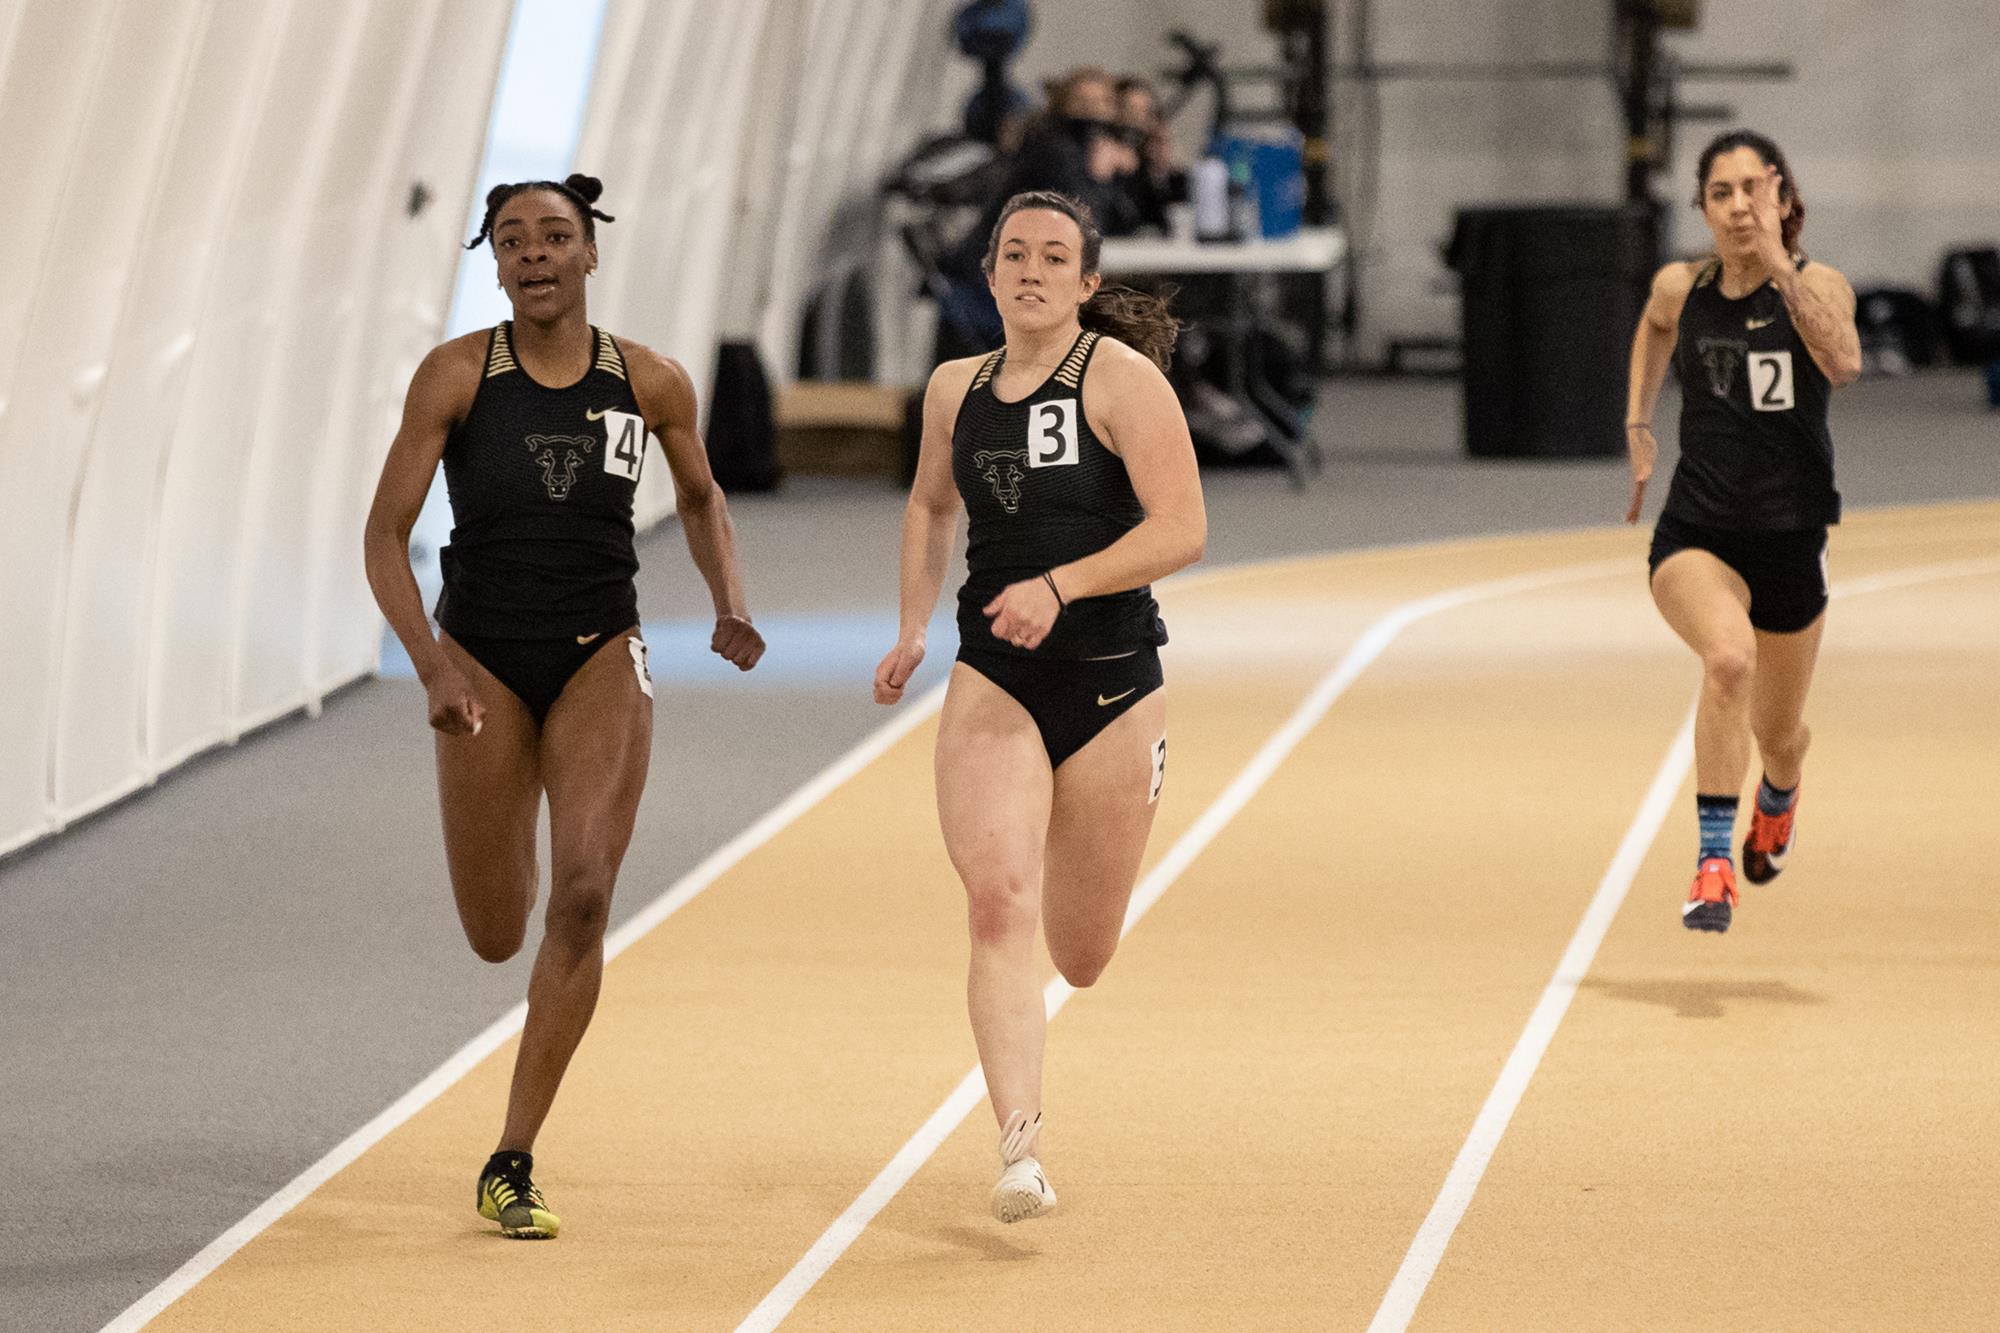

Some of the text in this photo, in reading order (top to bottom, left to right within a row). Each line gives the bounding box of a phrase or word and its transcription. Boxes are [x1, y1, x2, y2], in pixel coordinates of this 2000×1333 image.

[1759, 359, 1785, 405] 2
[614, 418, 638, 475] 4
[1039, 404, 1067, 463] 3
[1154, 738, 1166, 797] 3
